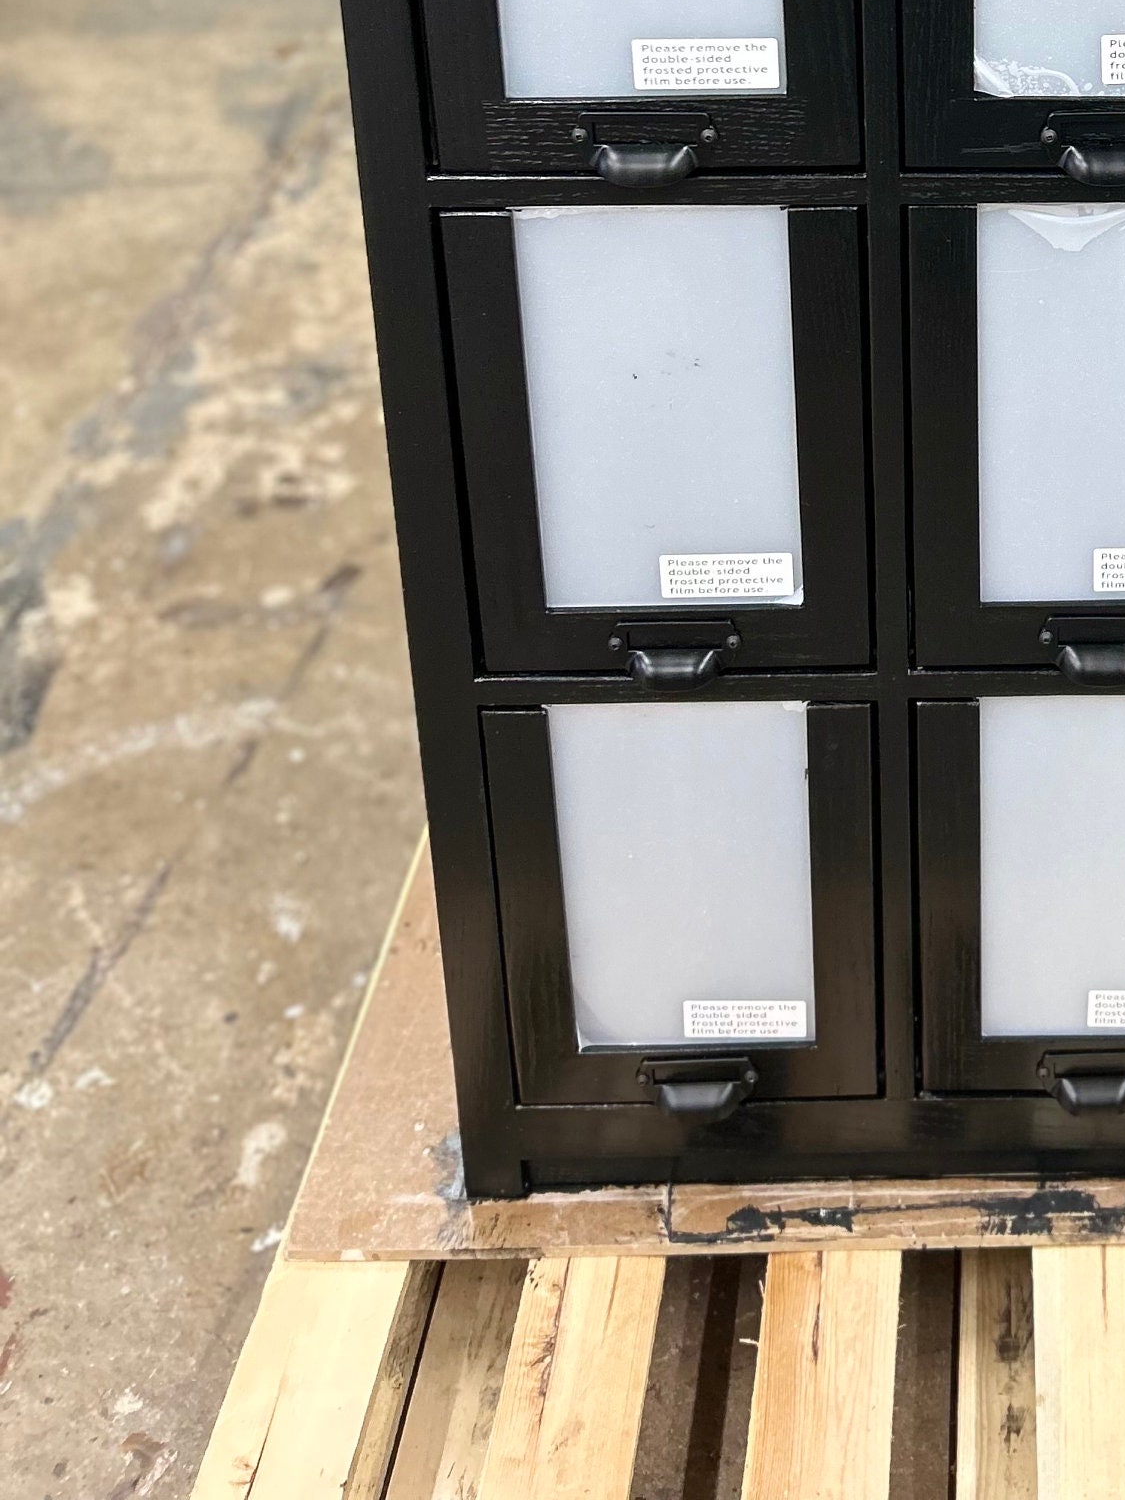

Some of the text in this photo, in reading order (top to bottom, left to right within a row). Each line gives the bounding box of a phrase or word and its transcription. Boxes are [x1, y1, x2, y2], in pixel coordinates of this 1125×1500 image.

[641, 42, 768, 53] Please remove the
[642, 65, 769, 76] frosted protective
[643, 76, 671, 86] film
[674, 76, 720, 86] before
[667, 559, 709, 567] Please
[762, 557, 783, 565] the
[669, 576, 784, 586] frosted protective
[1101, 580, 1125, 589] film
[669, 587, 695, 595] film
[698, 586, 740, 595] before
[691, 1019, 734, 1027] frosted
[691, 1027, 715, 1035] film
[718, 1027, 757, 1035] before
